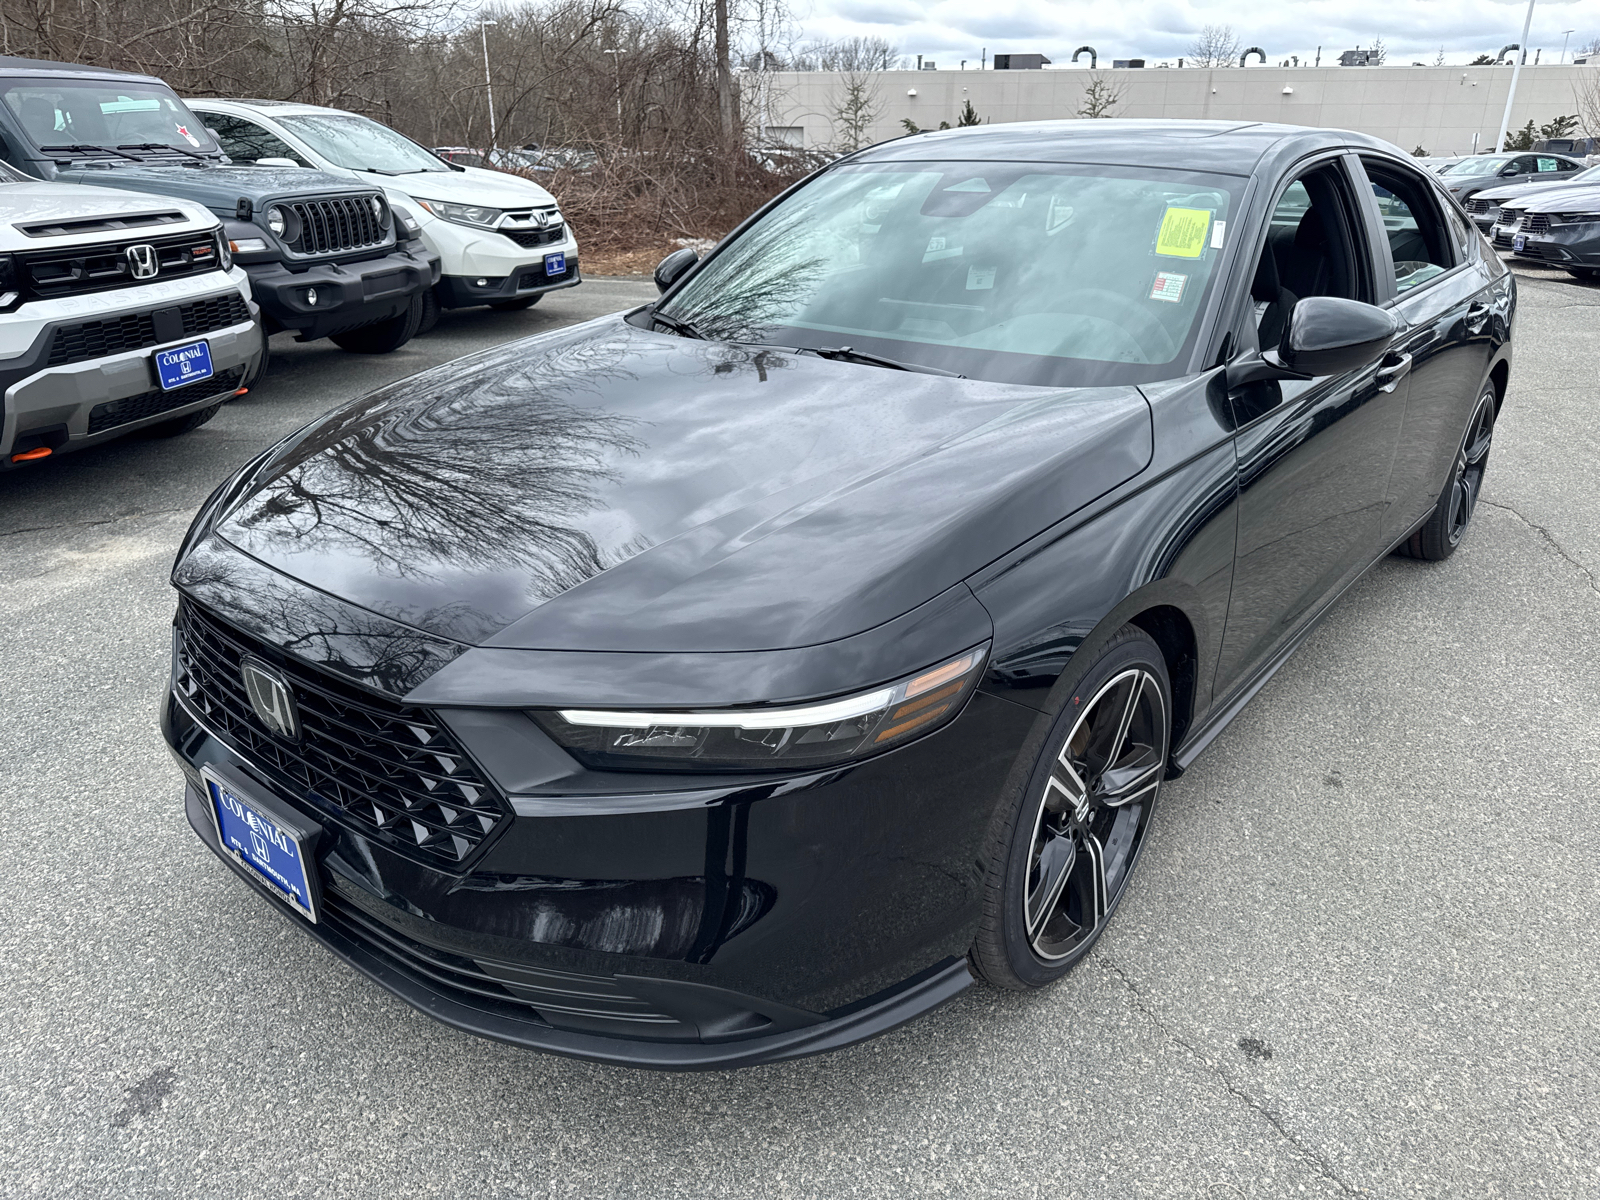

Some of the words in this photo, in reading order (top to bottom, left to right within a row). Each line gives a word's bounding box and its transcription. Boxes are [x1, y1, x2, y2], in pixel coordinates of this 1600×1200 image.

[56, 274, 221, 313] PASSPORT
[163, 348, 204, 366] COLONIAL
[220, 787, 294, 858] COLONIAL
